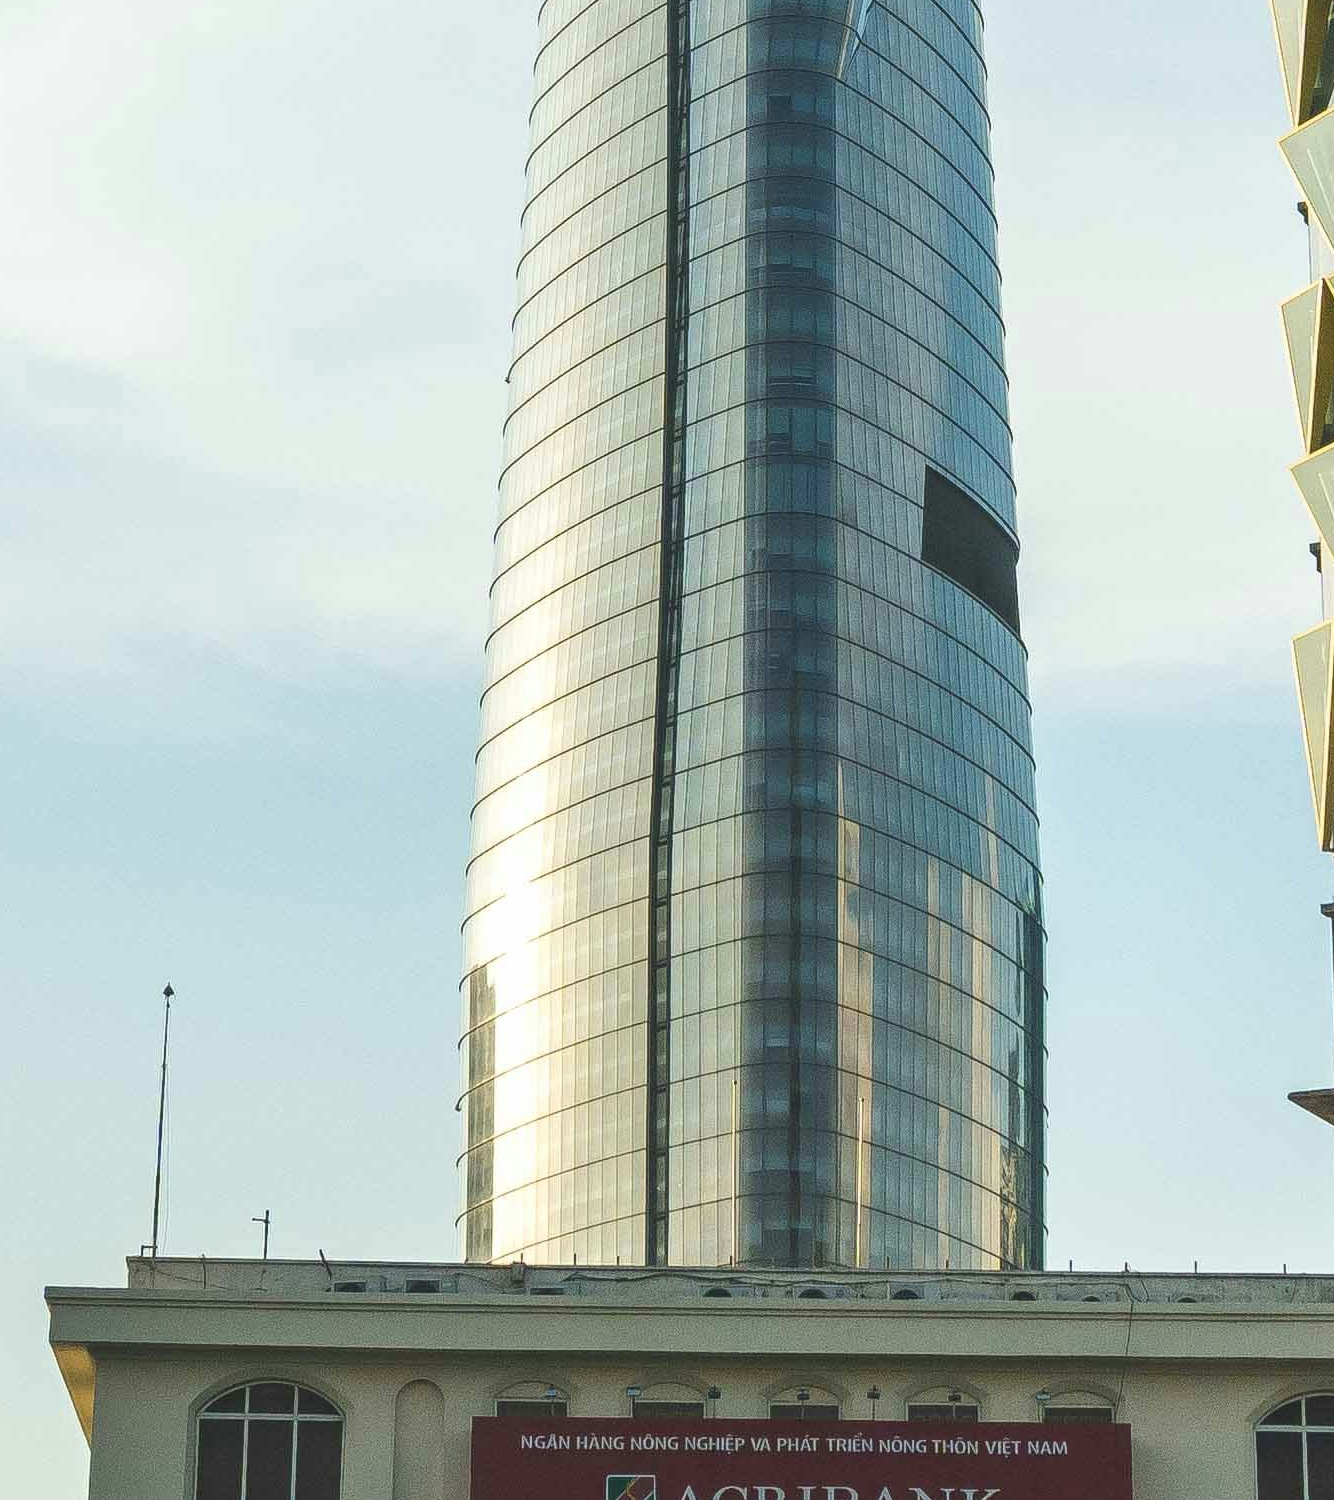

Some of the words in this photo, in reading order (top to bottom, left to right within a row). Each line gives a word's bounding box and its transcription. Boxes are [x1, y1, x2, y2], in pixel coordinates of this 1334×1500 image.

[521, 1433, 570, 1450] NGÂN
[576, 1433, 625, 1451] HÀNG
[630, 1434, 679, 1451] NÔNG
[684, 1434, 745, 1455] NGHIỆP
[777, 1434, 819, 1452] PHÁT
[827, 1432, 874, 1452] TRIỂN
[879, 1435, 927, 1454] NÔNG
[932, 1436, 979, 1455] THÔN
[985, 1436, 1021, 1458] VIỆT
[1027, 1441, 1067, 1455] NAM
